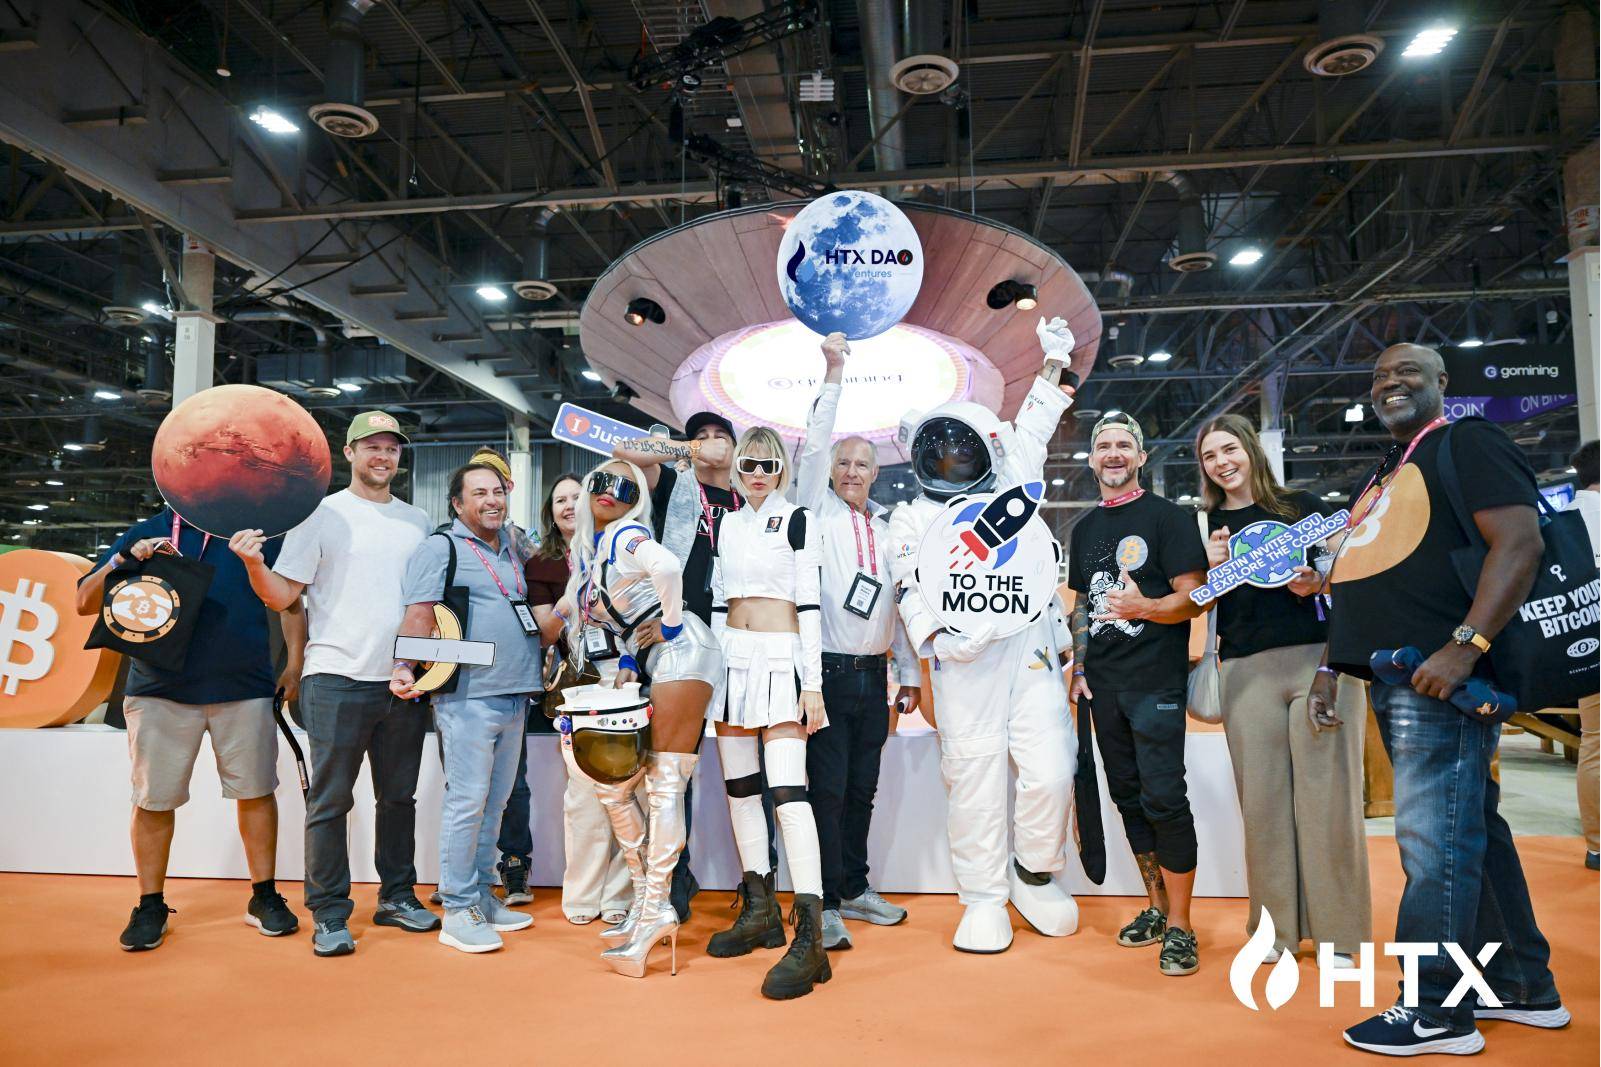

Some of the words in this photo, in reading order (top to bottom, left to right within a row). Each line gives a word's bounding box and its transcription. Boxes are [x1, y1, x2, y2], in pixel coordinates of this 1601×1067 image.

[825, 249, 866, 265] HTX
[1500, 364, 1559, 379] gomining
[1520, 396, 1539, 413] ON
[571, 417, 582, 433] I
[1194, 588, 1211, 601] TO
[1212, 558, 1267, 592] EXPLORE
[1266, 545, 1291, 562] THE
[1292, 512, 1350, 548] COSMOS!
[1210, 558, 1249, 583] JUSTIN
[1249, 531, 1294, 561] INVITES
[1293, 516, 1320, 534] YOU
[949, 573, 977, 590] TO
[985, 574, 1023, 592] THE
[942, 591, 1029, 614] MOON
[1518, 594, 1567, 623] KEEP
